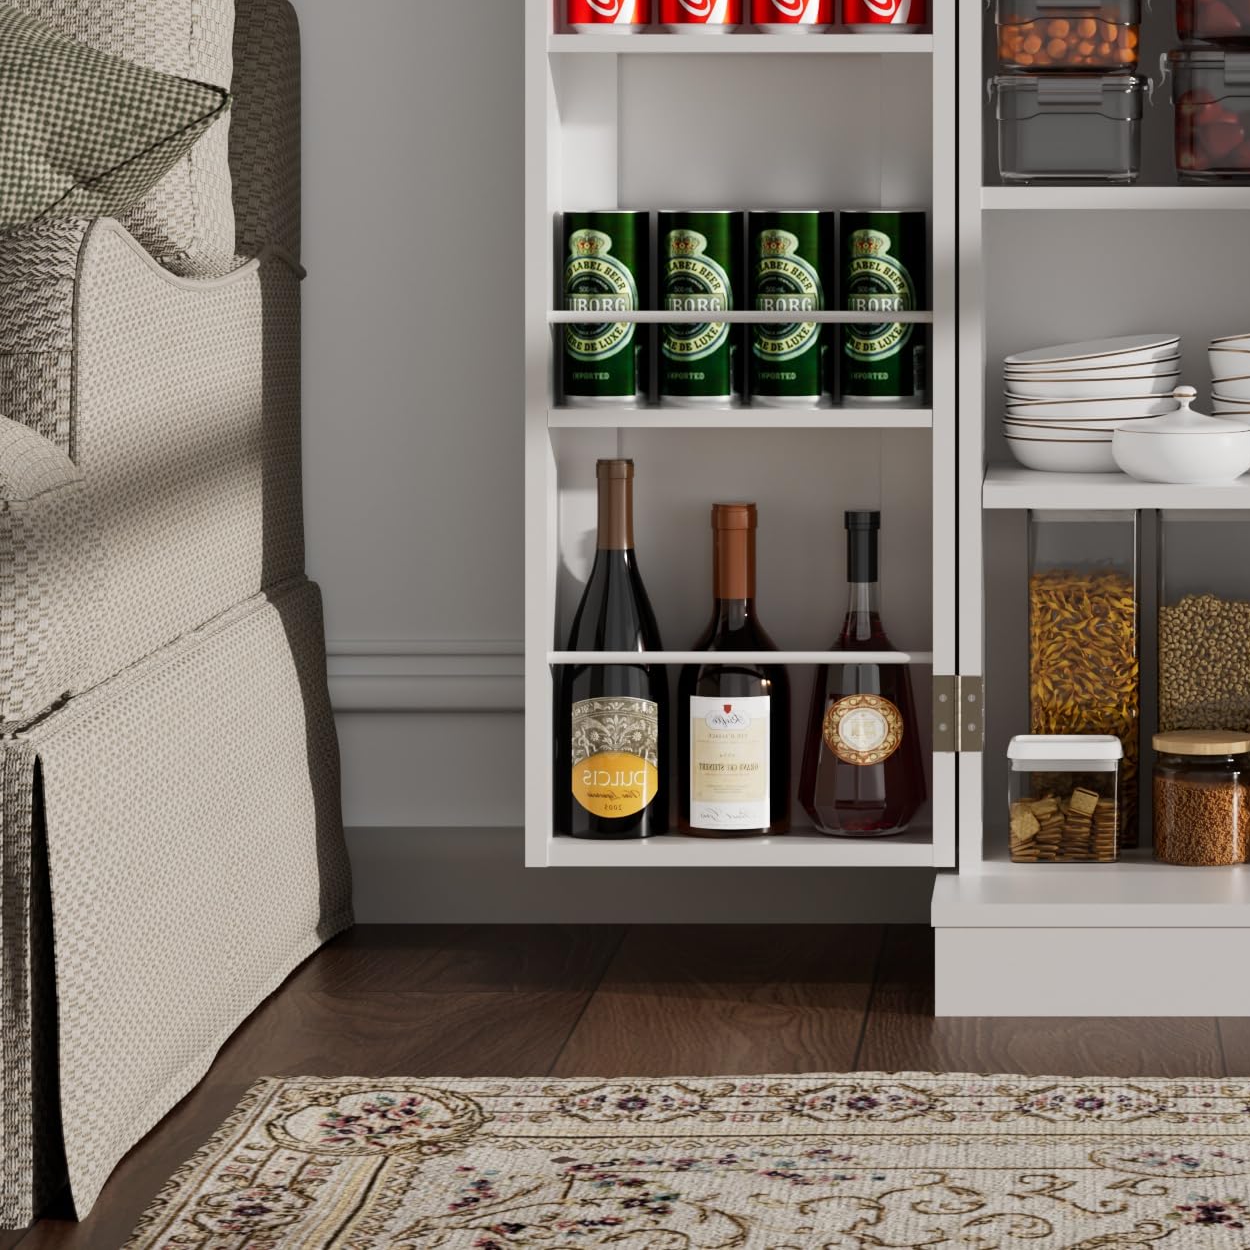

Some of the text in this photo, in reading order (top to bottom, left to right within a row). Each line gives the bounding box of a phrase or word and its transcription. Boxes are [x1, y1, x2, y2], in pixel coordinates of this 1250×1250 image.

[575, 261, 603, 272] LABEL
[604, 267, 626, 290] BEER
[699, 267, 721, 290] BEER
[790, 267, 813, 290] BEER
[883, 267, 906, 290] BEER
[584, 326, 624, 351] DE LUXE
[679, 326, 719, 351] DE LUXE
[771, 326, 810, 351] DE LUXE
[864, 326, 903, 351] DE LUXE
